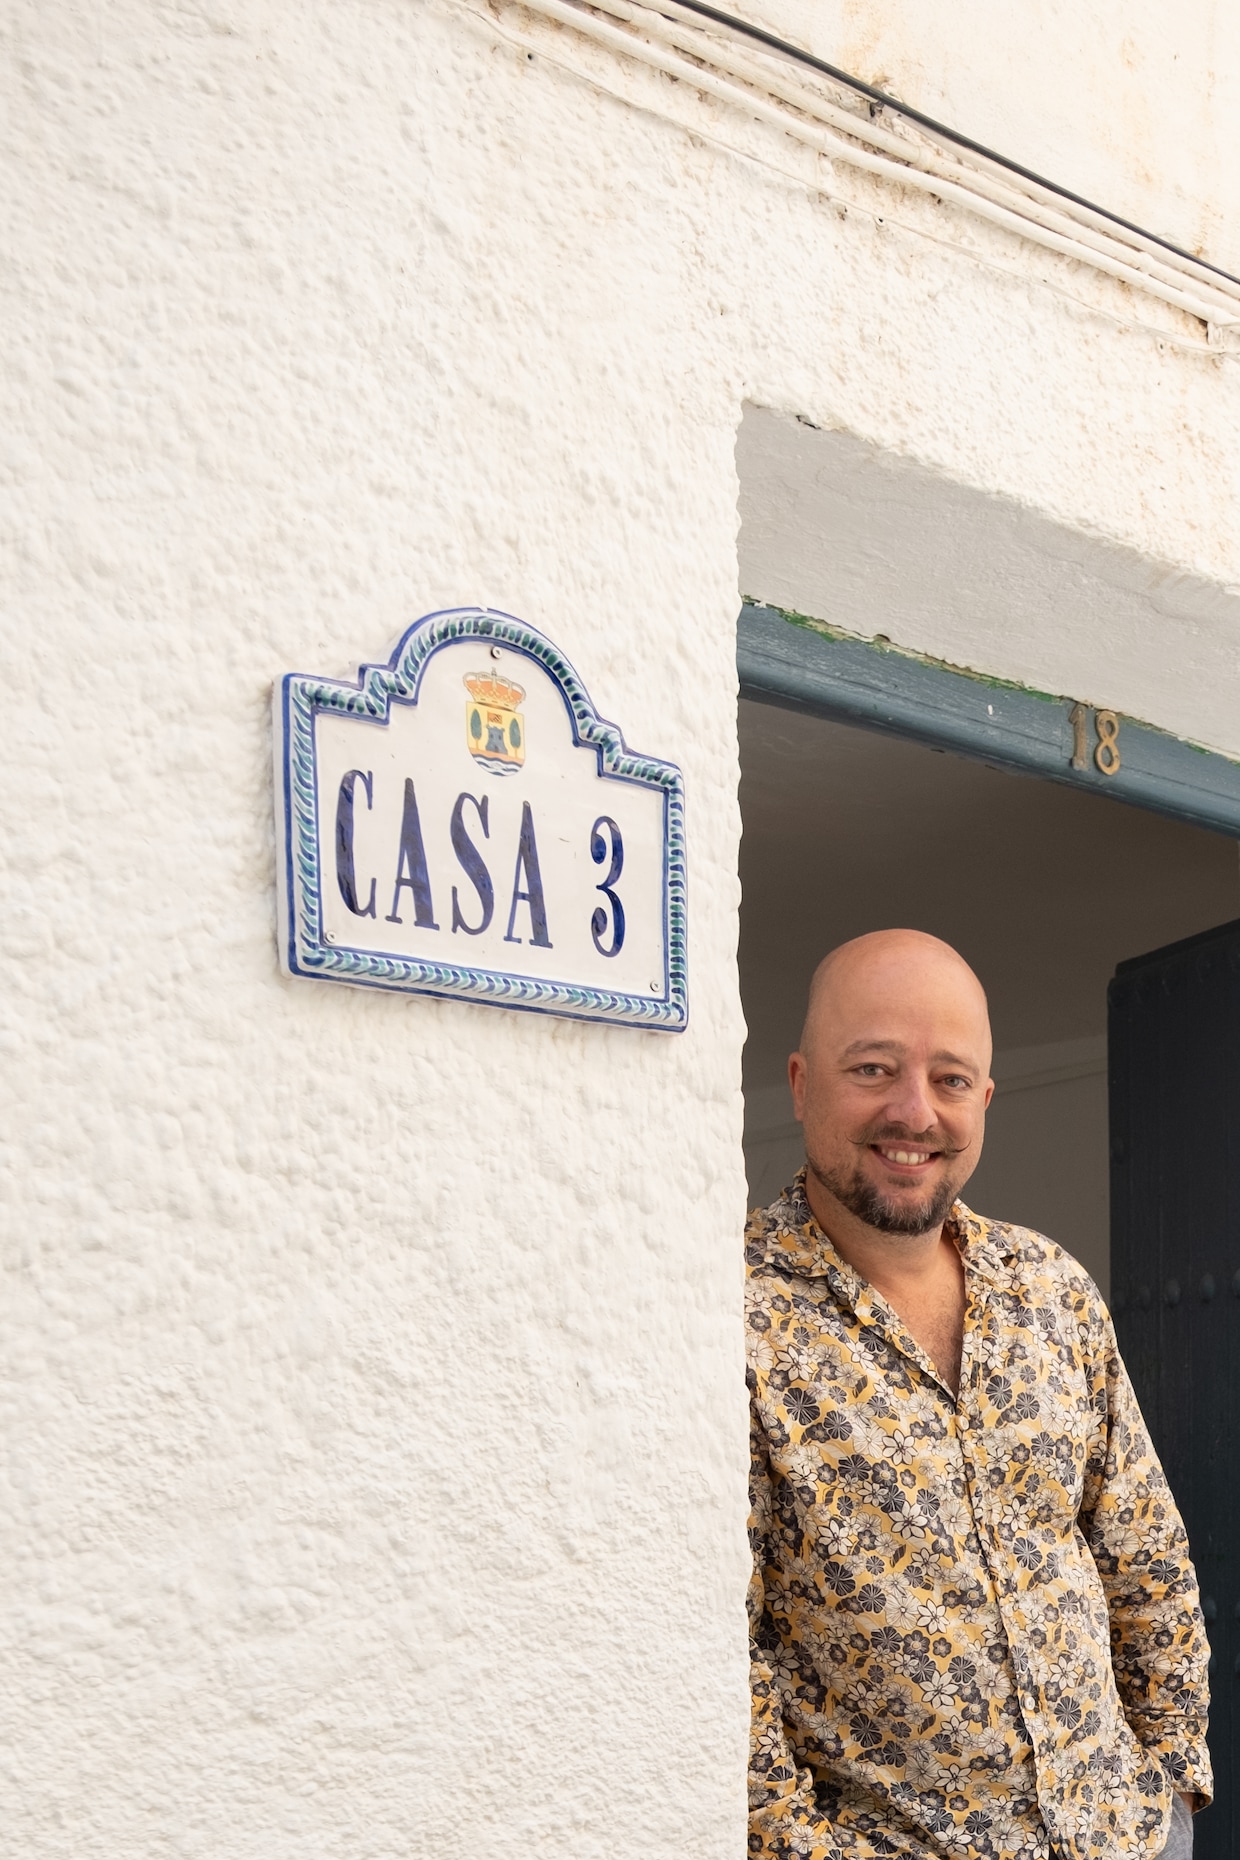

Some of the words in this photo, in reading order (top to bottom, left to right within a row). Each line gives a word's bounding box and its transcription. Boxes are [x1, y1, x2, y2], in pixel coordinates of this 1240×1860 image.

[1068, 703, 1120, 775] 18
[335, 769, 554, 949] CASA
[590, 815, 626, 958] 3
